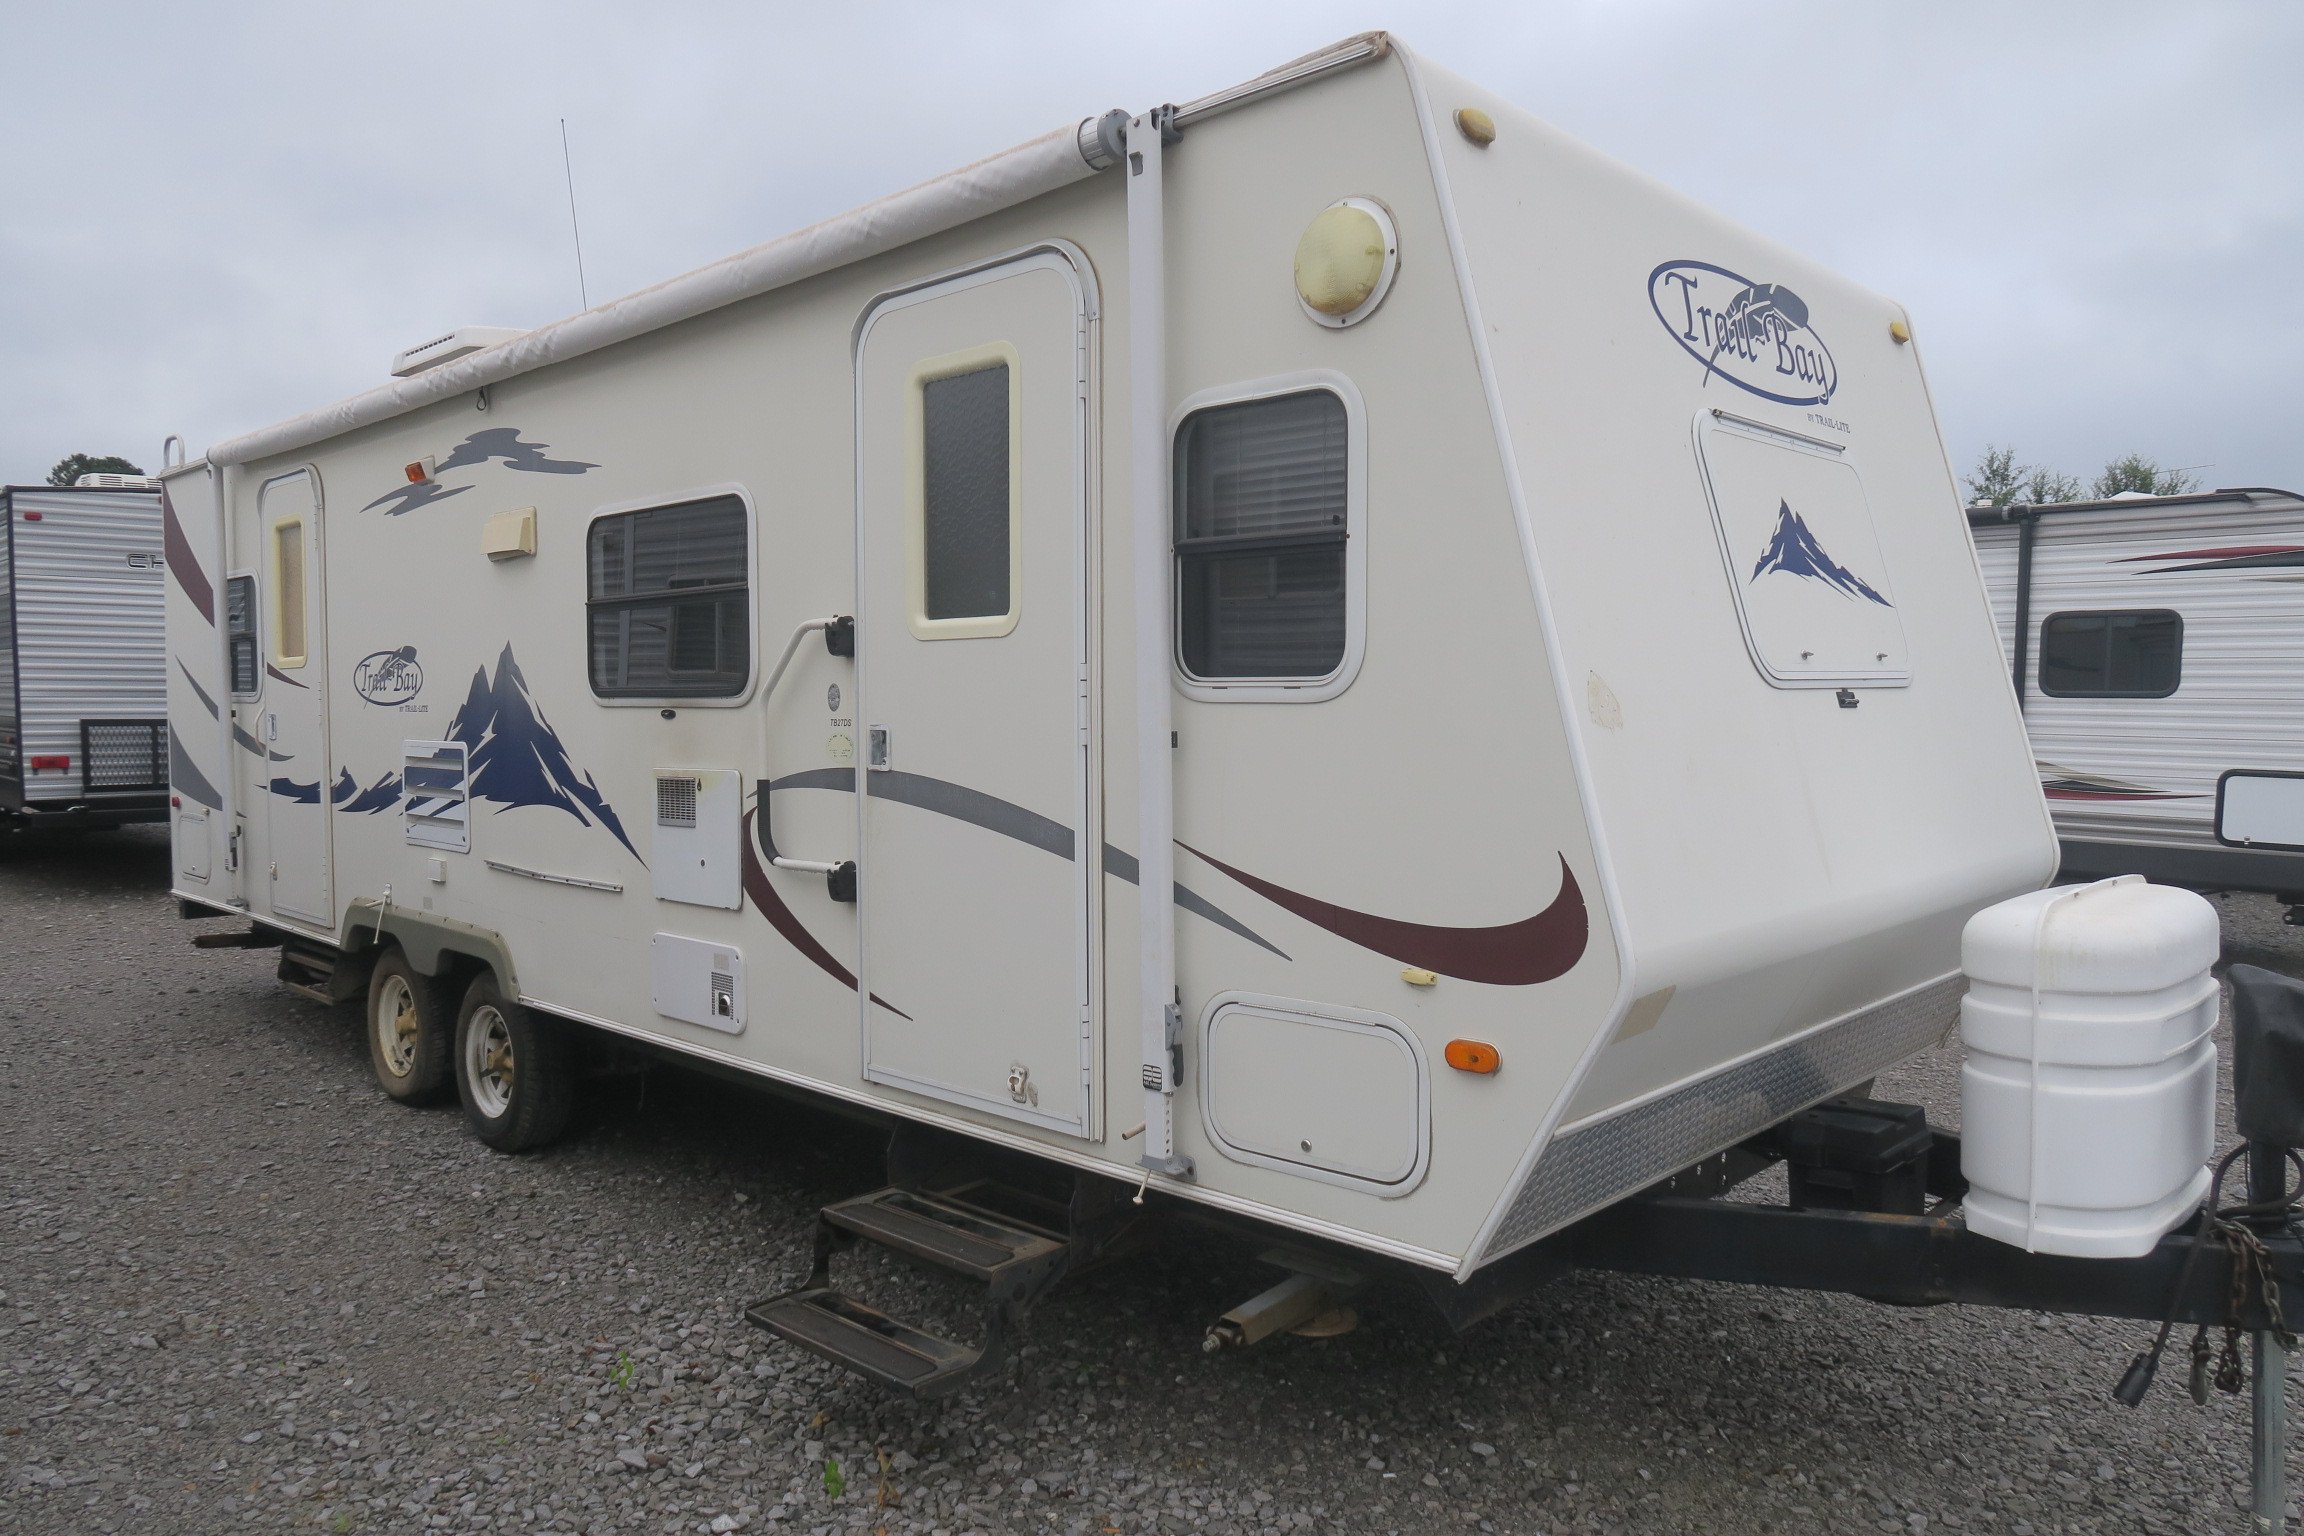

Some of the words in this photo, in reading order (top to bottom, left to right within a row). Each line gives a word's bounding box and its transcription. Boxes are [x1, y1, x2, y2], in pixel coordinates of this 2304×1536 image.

[1664, 271, 1757, 363] Trail
[1758, 310, 1829, 405] Bay
[389, 662, 418, 701] Bay
[830, 718, 852, 727] TB27DS
